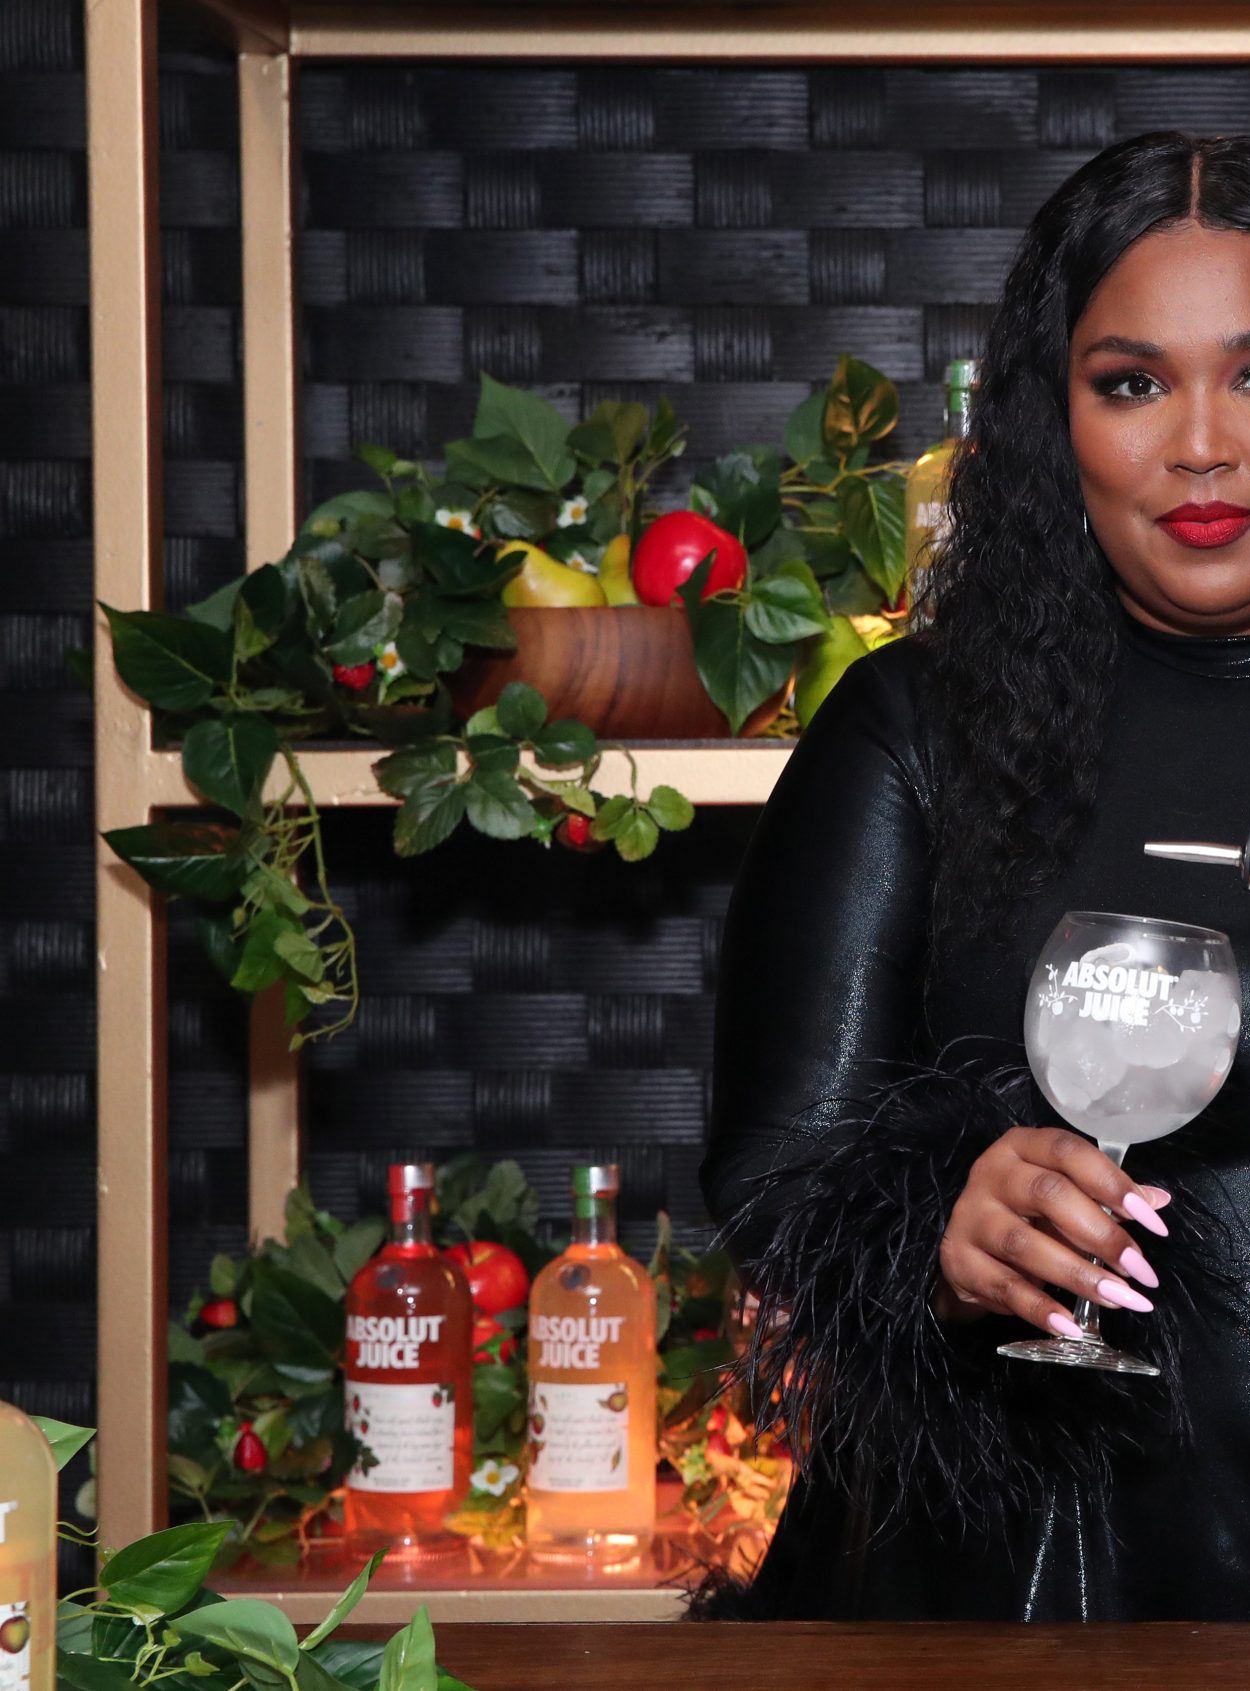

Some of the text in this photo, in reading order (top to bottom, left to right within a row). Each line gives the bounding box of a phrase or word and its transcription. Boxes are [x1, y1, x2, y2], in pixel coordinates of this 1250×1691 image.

[1062, 961, 1175, 1001] ABSOLUT
[1078, 992, 1150, 1026] JUICE
[355, 1341, 419, 1369] JUICE
[540, 1341, 600, 1369] JUICE
